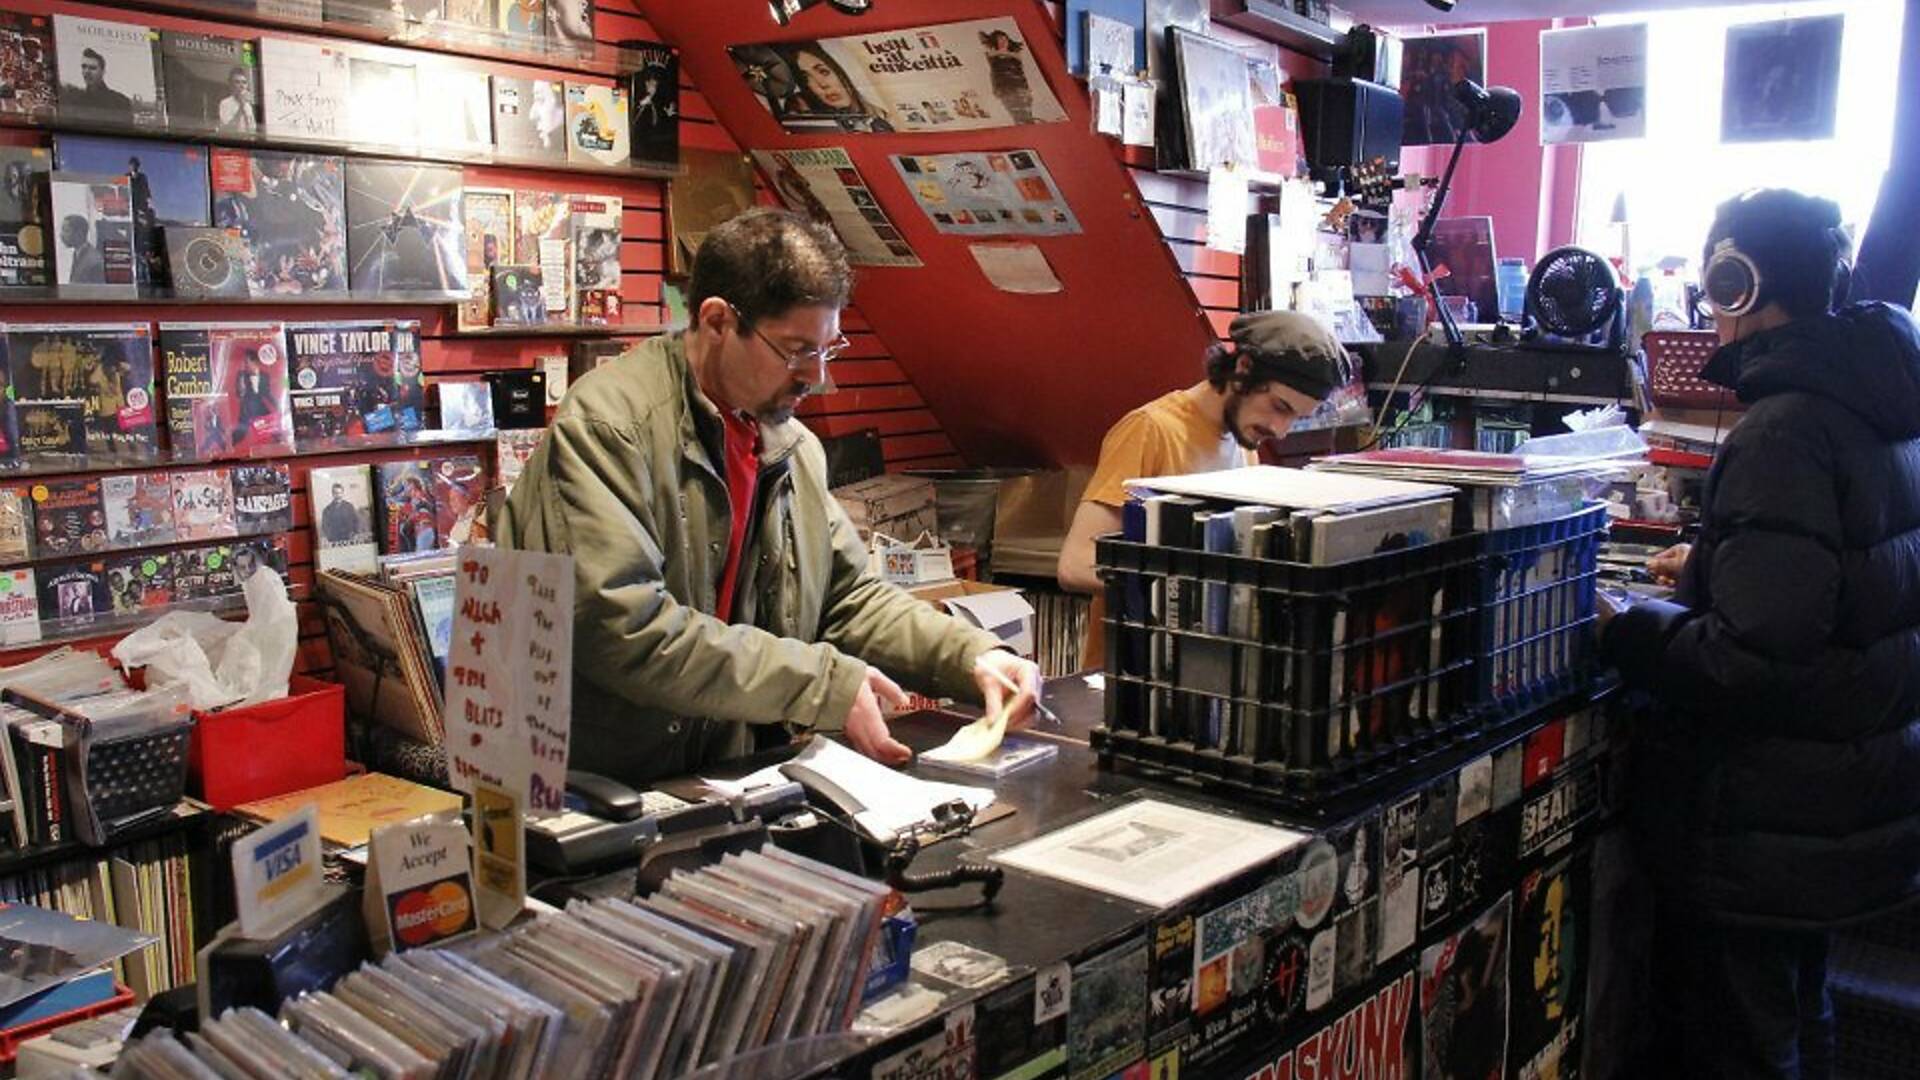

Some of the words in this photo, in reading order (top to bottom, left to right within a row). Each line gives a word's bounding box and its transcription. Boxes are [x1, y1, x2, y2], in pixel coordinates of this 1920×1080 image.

[77, 24, 146, 41] MORRISSEY
[294, 332, 337, 355] VINCE
[340, 331, 391, 353] TAYLOR
[166, 351, 207, 374] Robert
[410, 832, 433, 849] We
[264, 844, 301, 881] VISA
[400, 845, 448, 872] Accept
[395, 901, 467, 932] MasterCard
